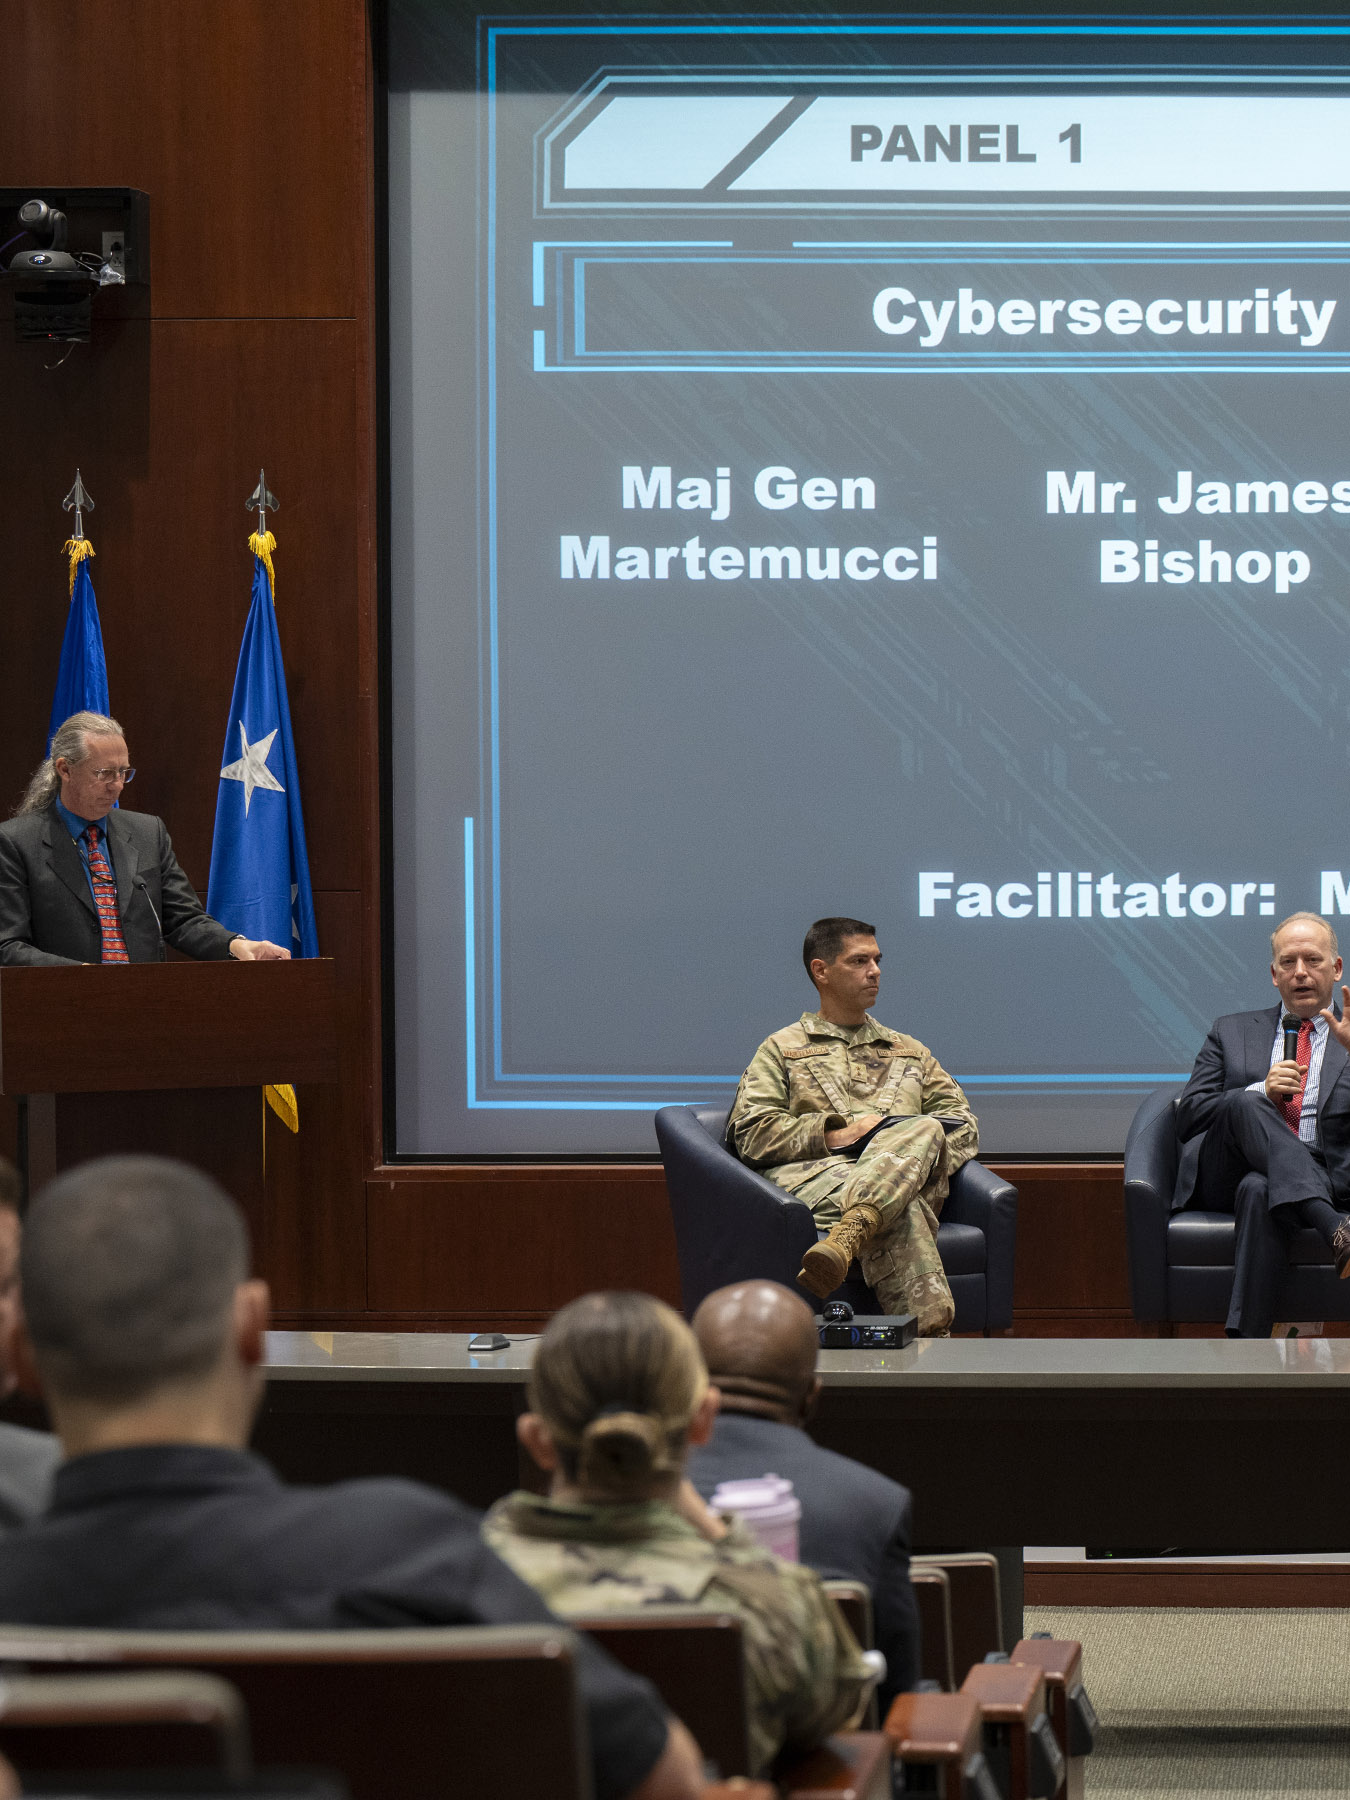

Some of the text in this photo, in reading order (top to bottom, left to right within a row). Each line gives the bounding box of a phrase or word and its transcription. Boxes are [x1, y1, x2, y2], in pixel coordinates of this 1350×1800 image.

[851, 124, 1081, 162] PANEL 1
[873, 288, 1336, 347] Cybersecurity
[621, 465, 876, 520] Maj Gen
[1046, 471, 1137, 513] Mr.
[560, 536, 938, 581] Martemucci
[1100, 539, 1311, 593] Bishop
[918, 870, 1276, 916] Facilitator:
